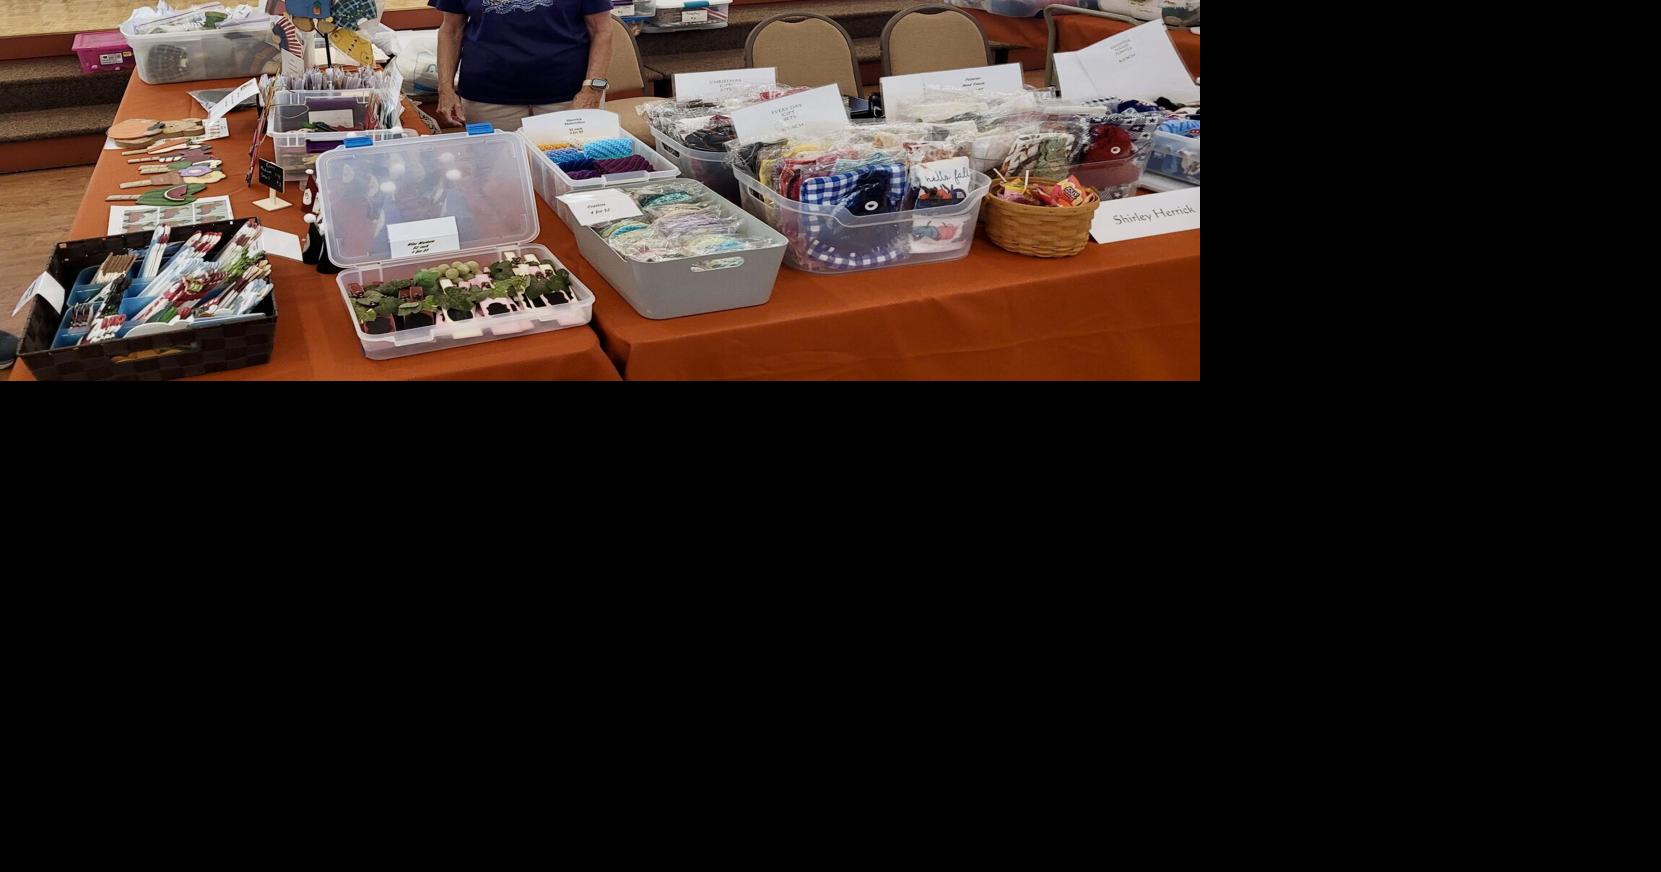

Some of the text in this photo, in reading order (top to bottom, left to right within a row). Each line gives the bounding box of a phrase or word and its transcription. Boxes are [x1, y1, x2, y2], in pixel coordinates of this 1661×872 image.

[954, 167, 970, 184] fall
[1112, 204, 1196, 225] Shirley Herrick
